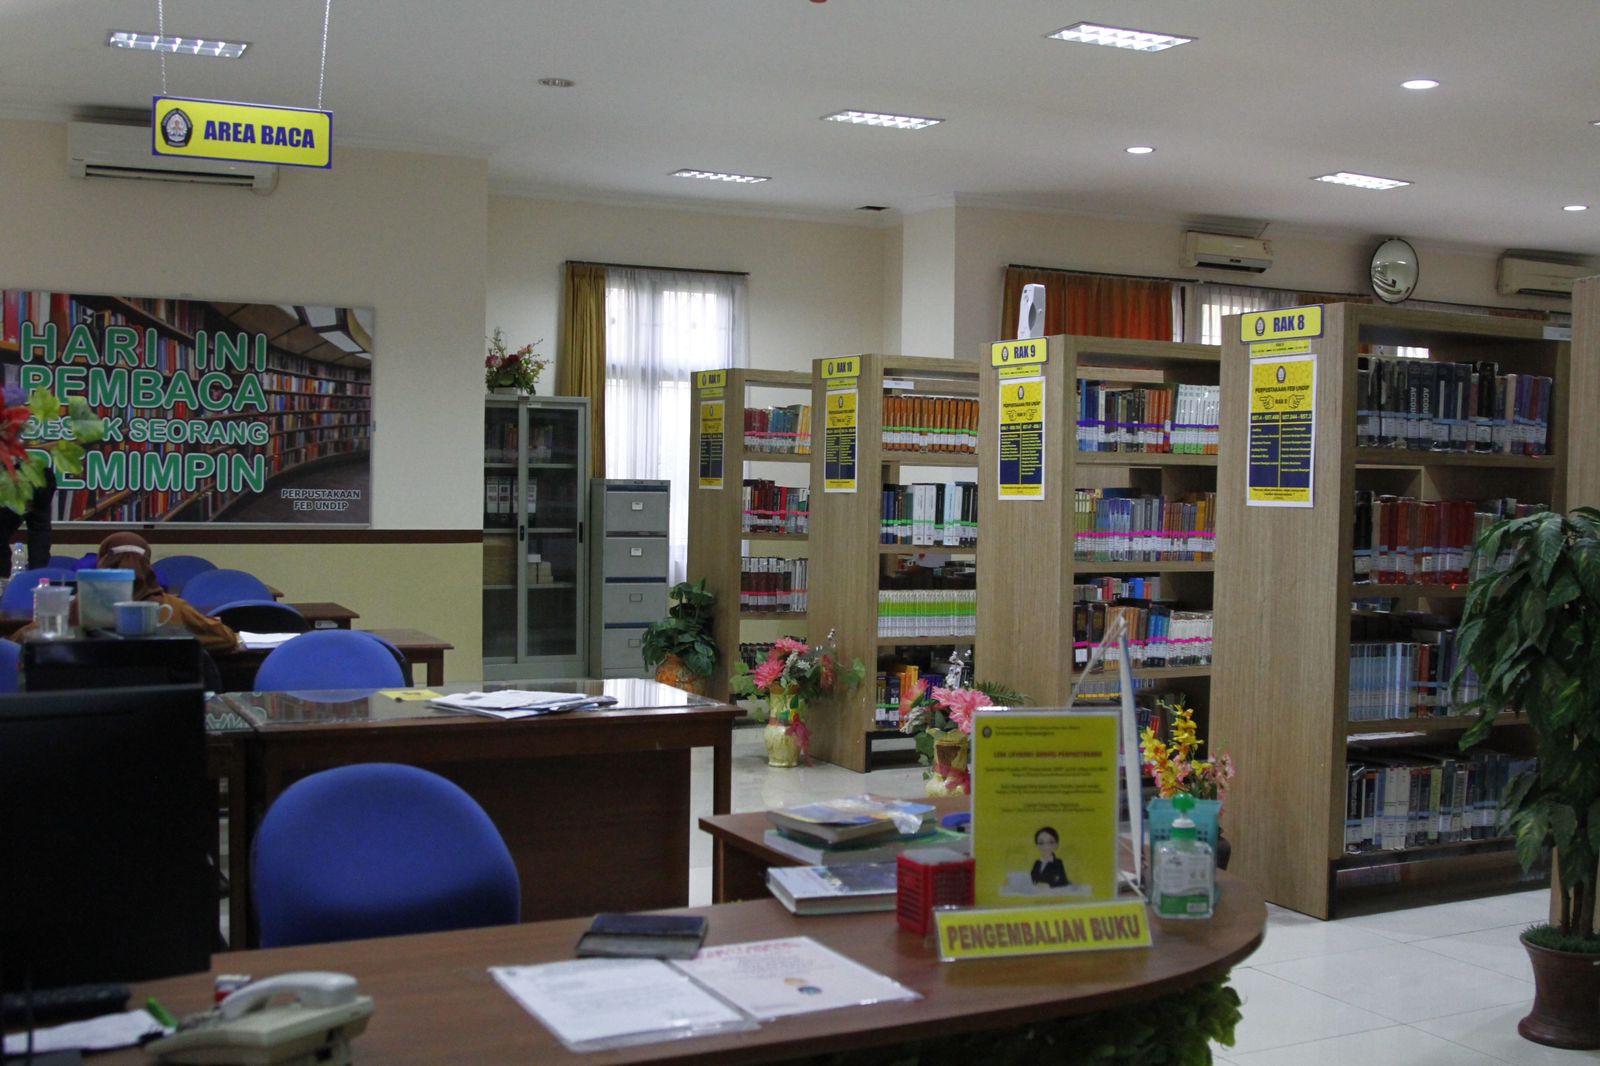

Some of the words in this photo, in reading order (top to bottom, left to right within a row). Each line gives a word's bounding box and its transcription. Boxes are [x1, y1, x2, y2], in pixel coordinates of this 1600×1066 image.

[204, 120, 256, 144] AREA
[261, 125, 315, 149] BACA
[1273, 316, 1295, 332] RAK
[1297, 314, 1304, 330] 8
[19, 321, 158, 368] HARI
[195, 330, 267, 373] INI
[1014, 346, 1029, 359] RAK
[1030, 345, 1036, 357] 9
[20, 364, 269, 413] PEMBACA
[20, 415, 122, 441] BESK
[129, 418, 269, 445] SEORANG
[281, 488, 361, 499] PERPUSTAKAAN
[293, 500, 313, 510] FEB
[315, 500, 349, 511] UNDIP
[946, 918, 1087, 950] PENGEMBALIAN
[1090, 915, 1141, 941] BUKU
